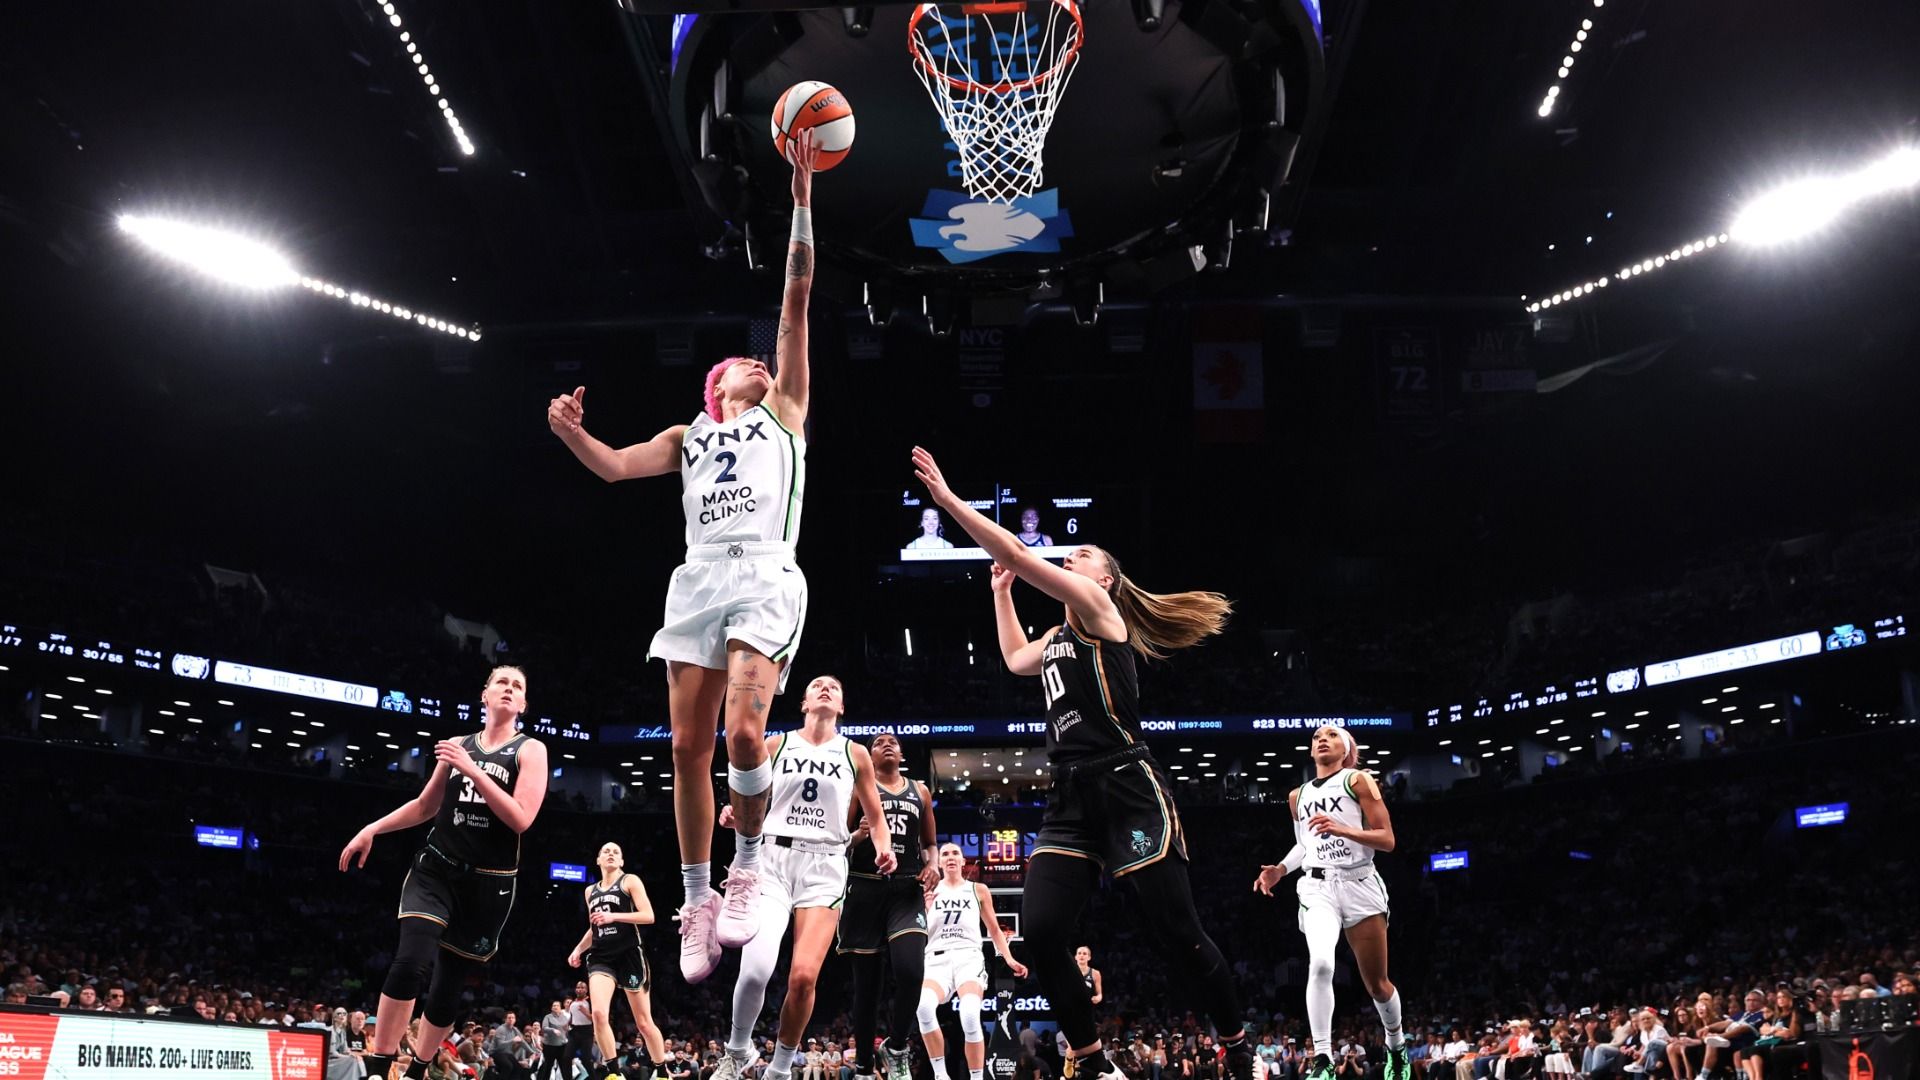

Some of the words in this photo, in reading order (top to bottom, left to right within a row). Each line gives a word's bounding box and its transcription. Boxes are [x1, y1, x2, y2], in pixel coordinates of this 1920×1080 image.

[960, 328, 1004, 345] NYC
[1390, 366, 1429, 391] 72
[682, 421, 768, 468] LYNX
[714, 451, 737, 484] 2
[702, 486, 752, 507] MAYO
[699, 499, 756, 525] CLINIC
[1066, 518, 1078, 535] 6
[1780, 637, 1803, 657] 60
[233, 665, 252, 684] 73
[344, 684, 364, 703] 60
[457, 711, 470, 721] 17
[1056, 709, 1080, 726] Liberty
[1252, 719, 1275, 730] #23
[1278, 718, 1302, 729] SUE
[1303, 717, 1345, 728] WICKS
[840, 725, 893, 735] REBECCA
[897, 724, 930, 735] LOBO
[1007, 722, 1025, 733] #11
[1059, 715, 1082, 733] Mutual
[633, 726, 672, 739] Libert
[782, 758, 842, 780] LYNX
[802, 777, 818, 802] 8
[791, 805, 824, 817] MAYO
[1299, 797, 1343, 821] LYNX
[466, 813, 490, 823] Liberty
[466, 820, 489, 828] Mutual
[786, 816, 826, 829] CLINIC
[886, 813, 908, 836] 35
[992, 829, 1018, 842] 7:32
[988, 842, 1016, 862] 20
[1316, 839, 1345, 854] MAYO
[935, 900, 971, 910] LYNX
[943, 910, 962, 925] 77
[998, 990, 1012, 999] ally
[0, 1033, 15, 1043] BA
[0, 1046, 42, 1060] AGUE
[78, 1044, 101, 1068] BIG
[106, 1045, 155, 1069] NAMES.
[160, 1047, 187, 1069] 200+
[191, 1049, 213, 1069] LIVE
[217, 1050, 254, 1070] GAMES.
[0, 1062, 20, 1075] SS
[286, 1057, 318, 1068] LEAGUE
[286, 1069, 307, 1079] PASS
